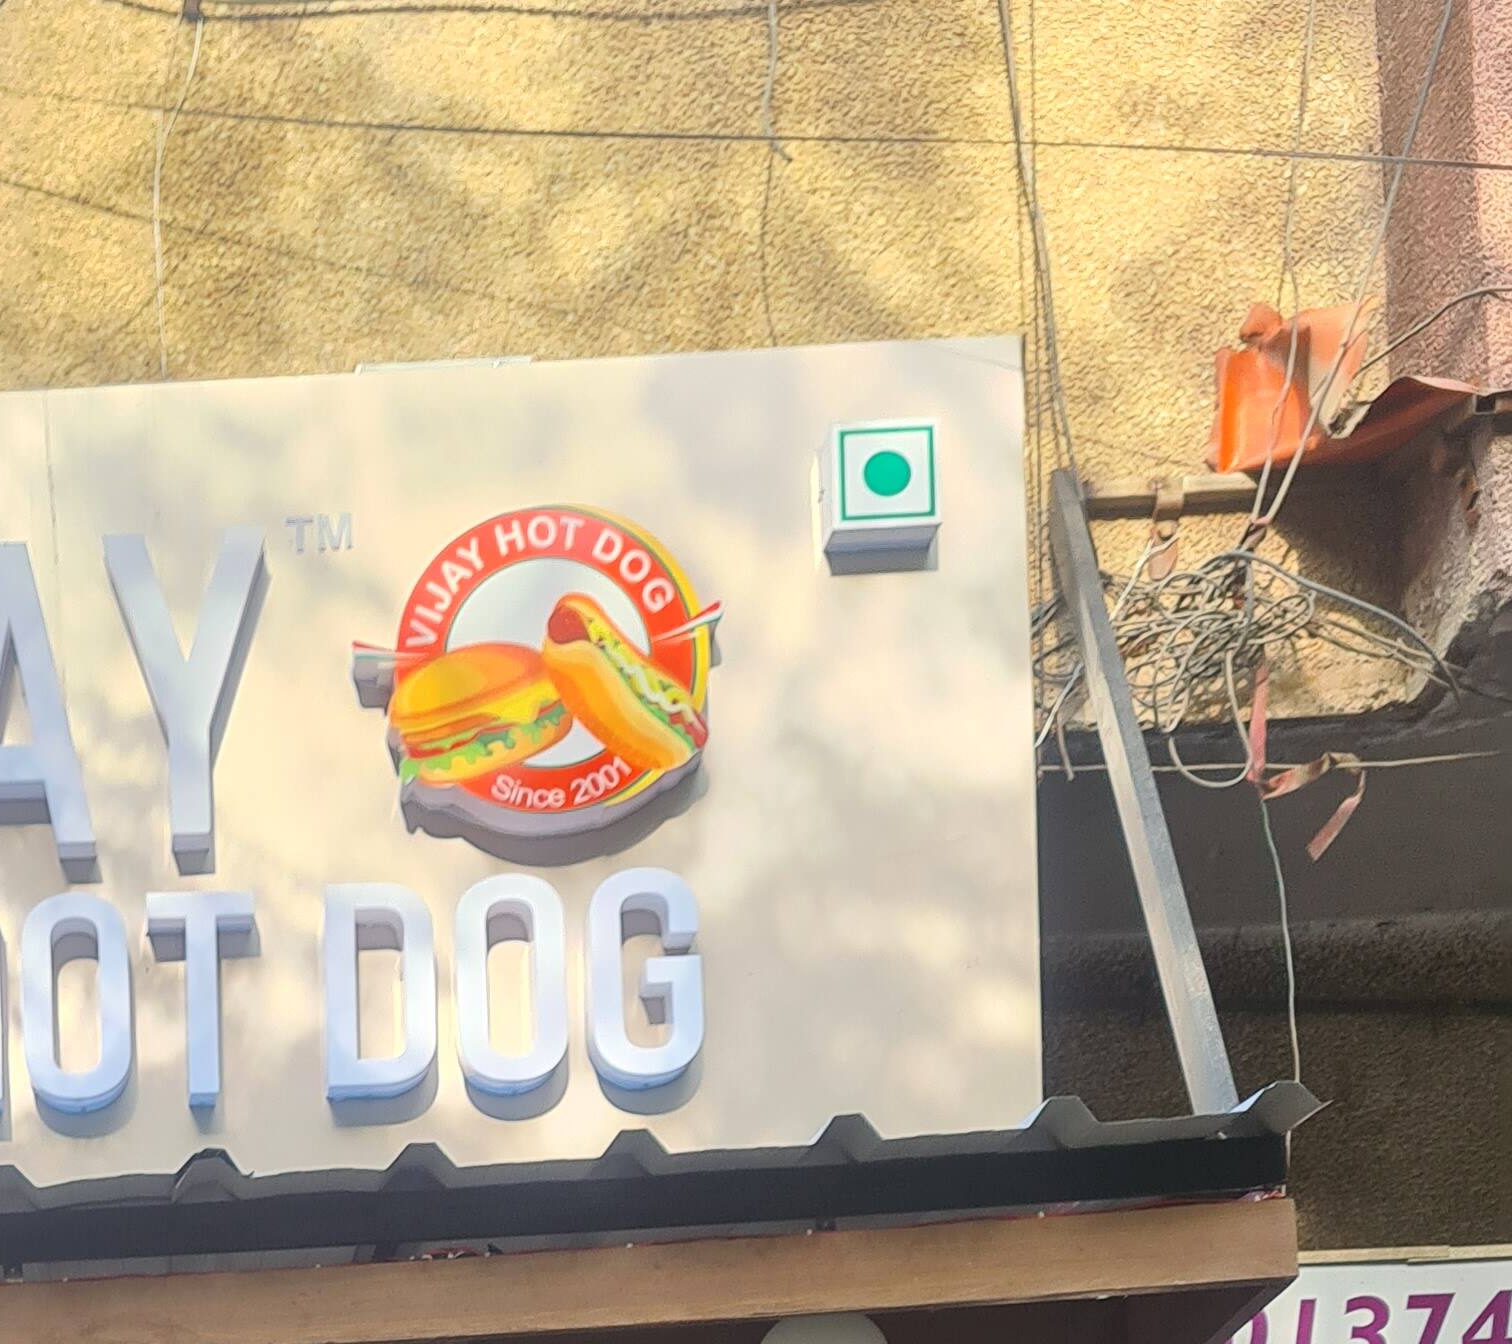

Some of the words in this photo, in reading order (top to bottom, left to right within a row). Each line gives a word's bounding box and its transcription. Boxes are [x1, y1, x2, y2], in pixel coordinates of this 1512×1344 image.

[285, 512, 353, 555] TM
[407, 540, 488, 648] VIJAY
[494, 516, 584, 556] HOT
[592, 529, 675, 613] DOG
[491, 774, 566, 809] Since
[572, 756, 632, 806] 2001
[325, 868, 706, 1102] DOG
